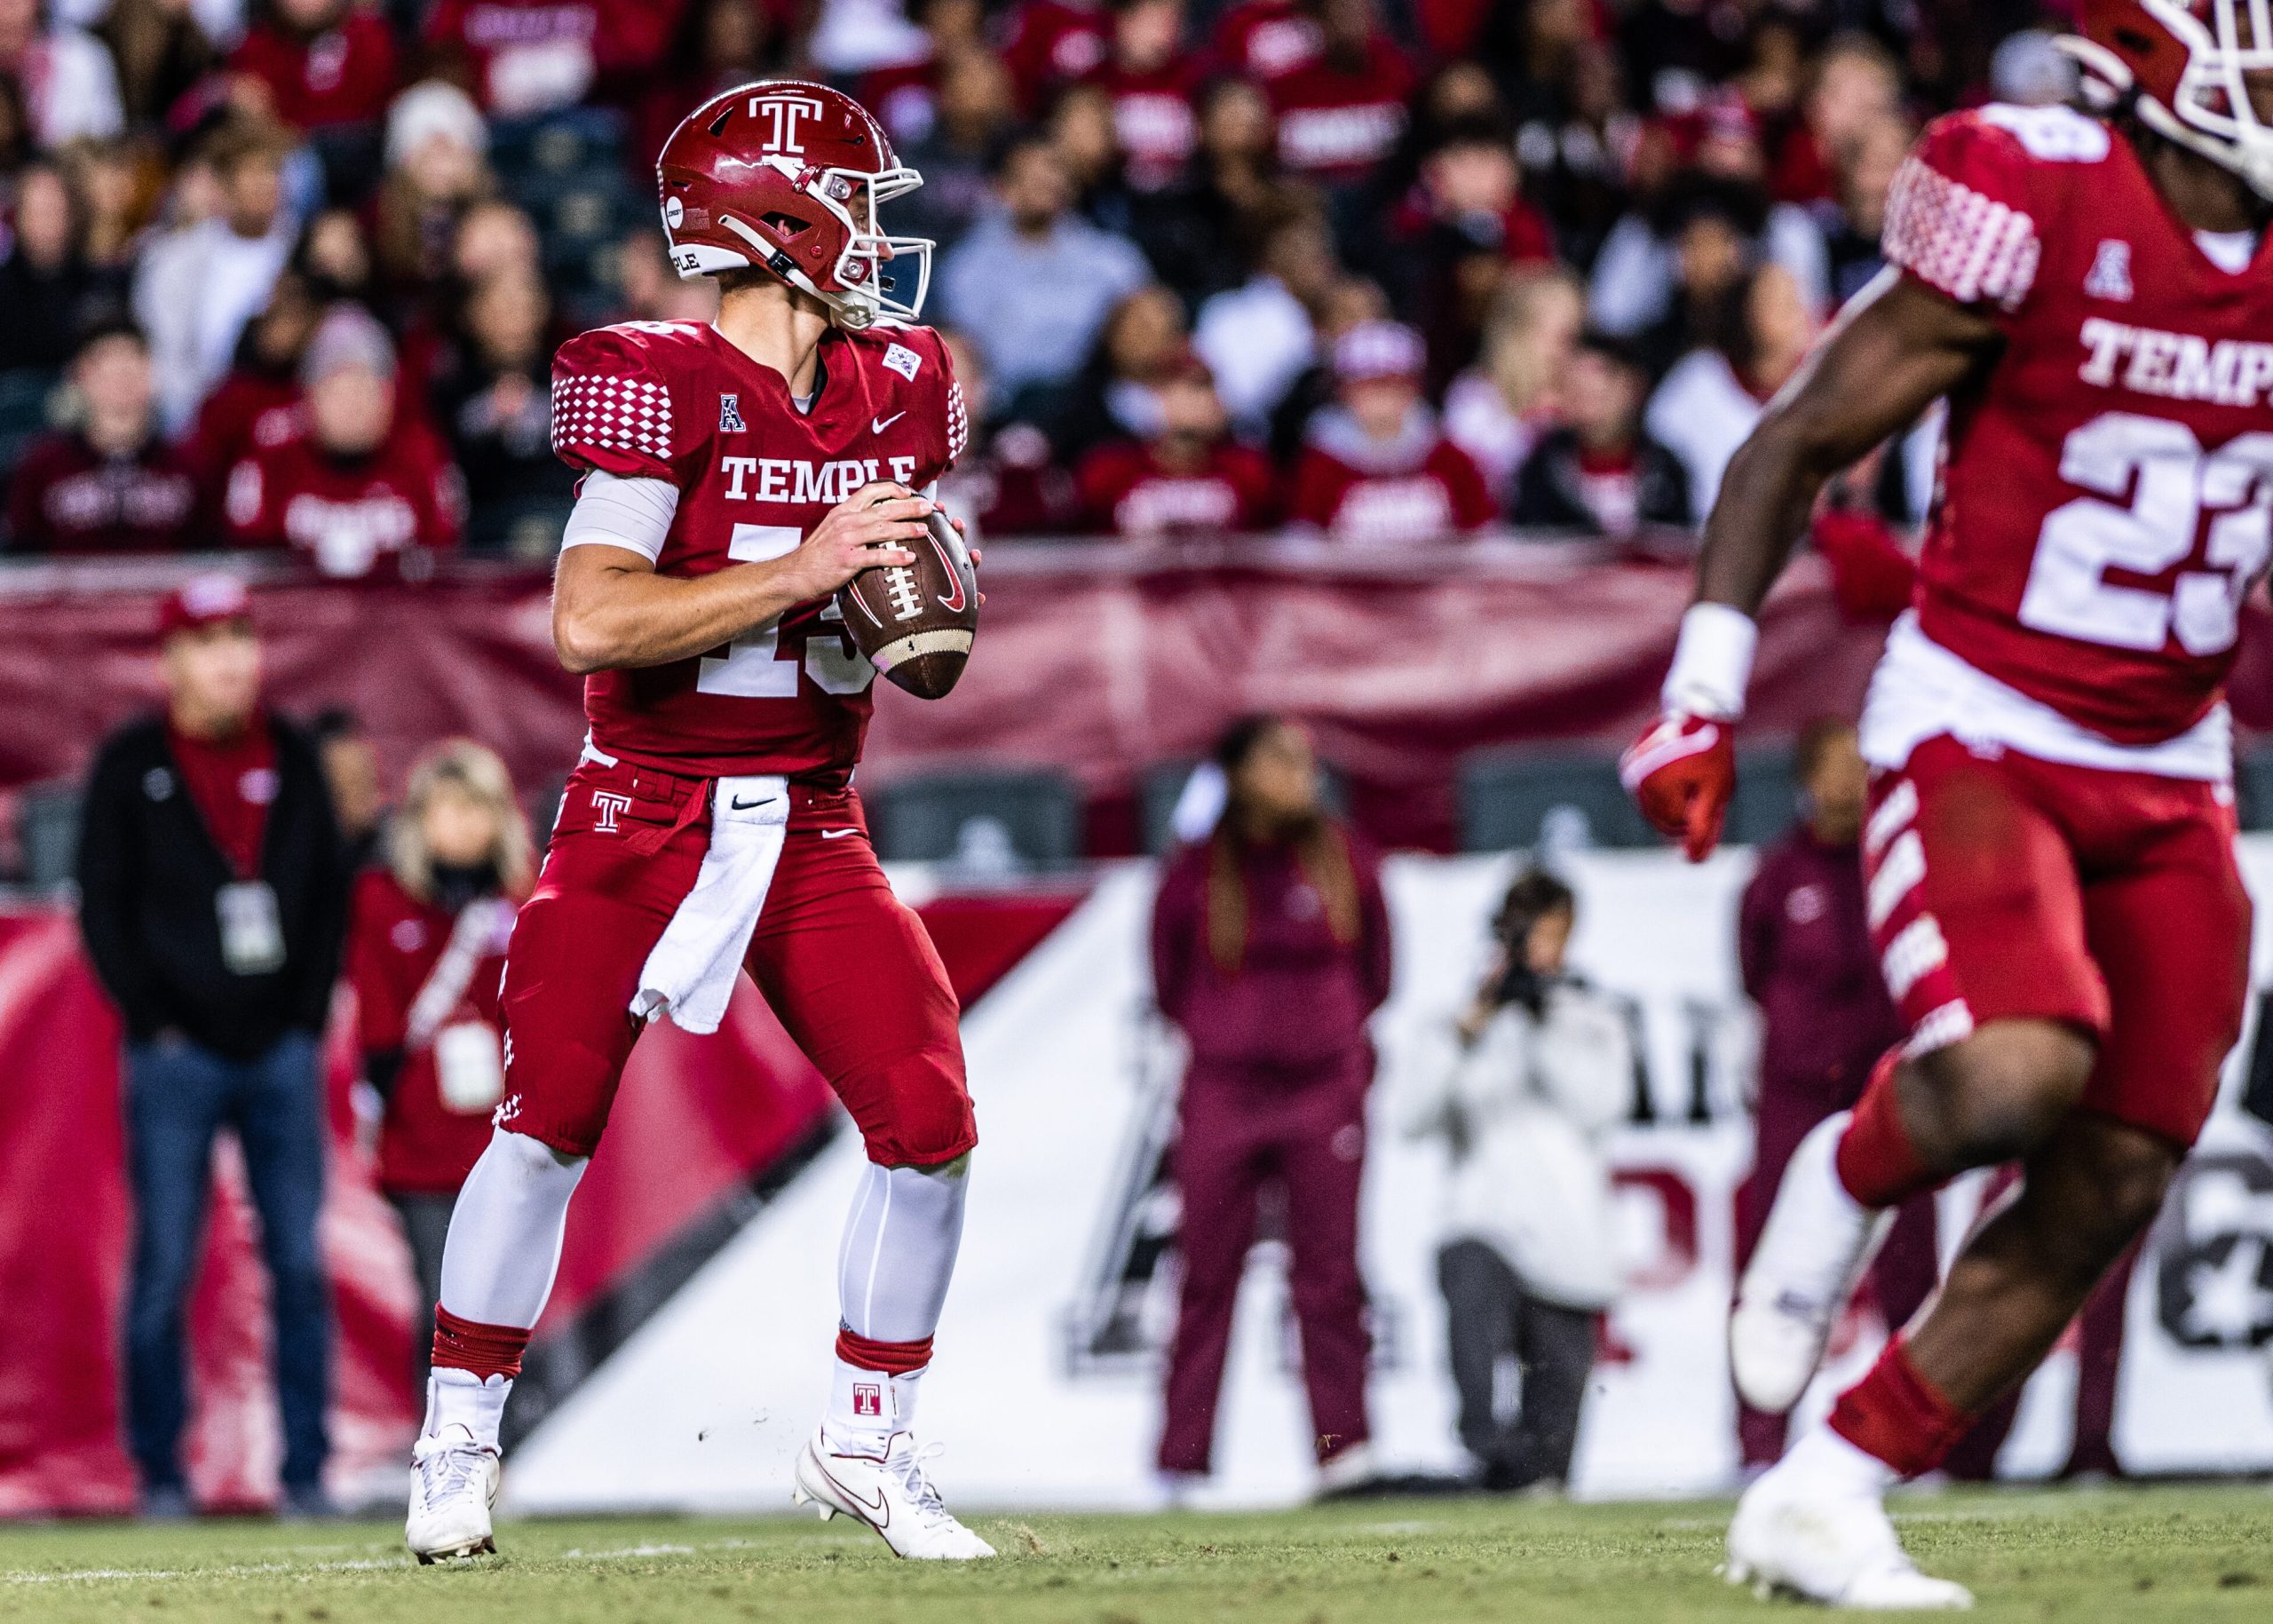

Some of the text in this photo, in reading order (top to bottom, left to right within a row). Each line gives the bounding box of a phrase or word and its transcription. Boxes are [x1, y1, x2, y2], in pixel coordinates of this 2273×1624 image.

[748, 95, 823, 166] T
[2078, 316, 2273, 408] TEMP
[2016, 411, 2273, 657] 23
[590, 789, 633, 833] T
[853, 1383, 880, 1414] T
